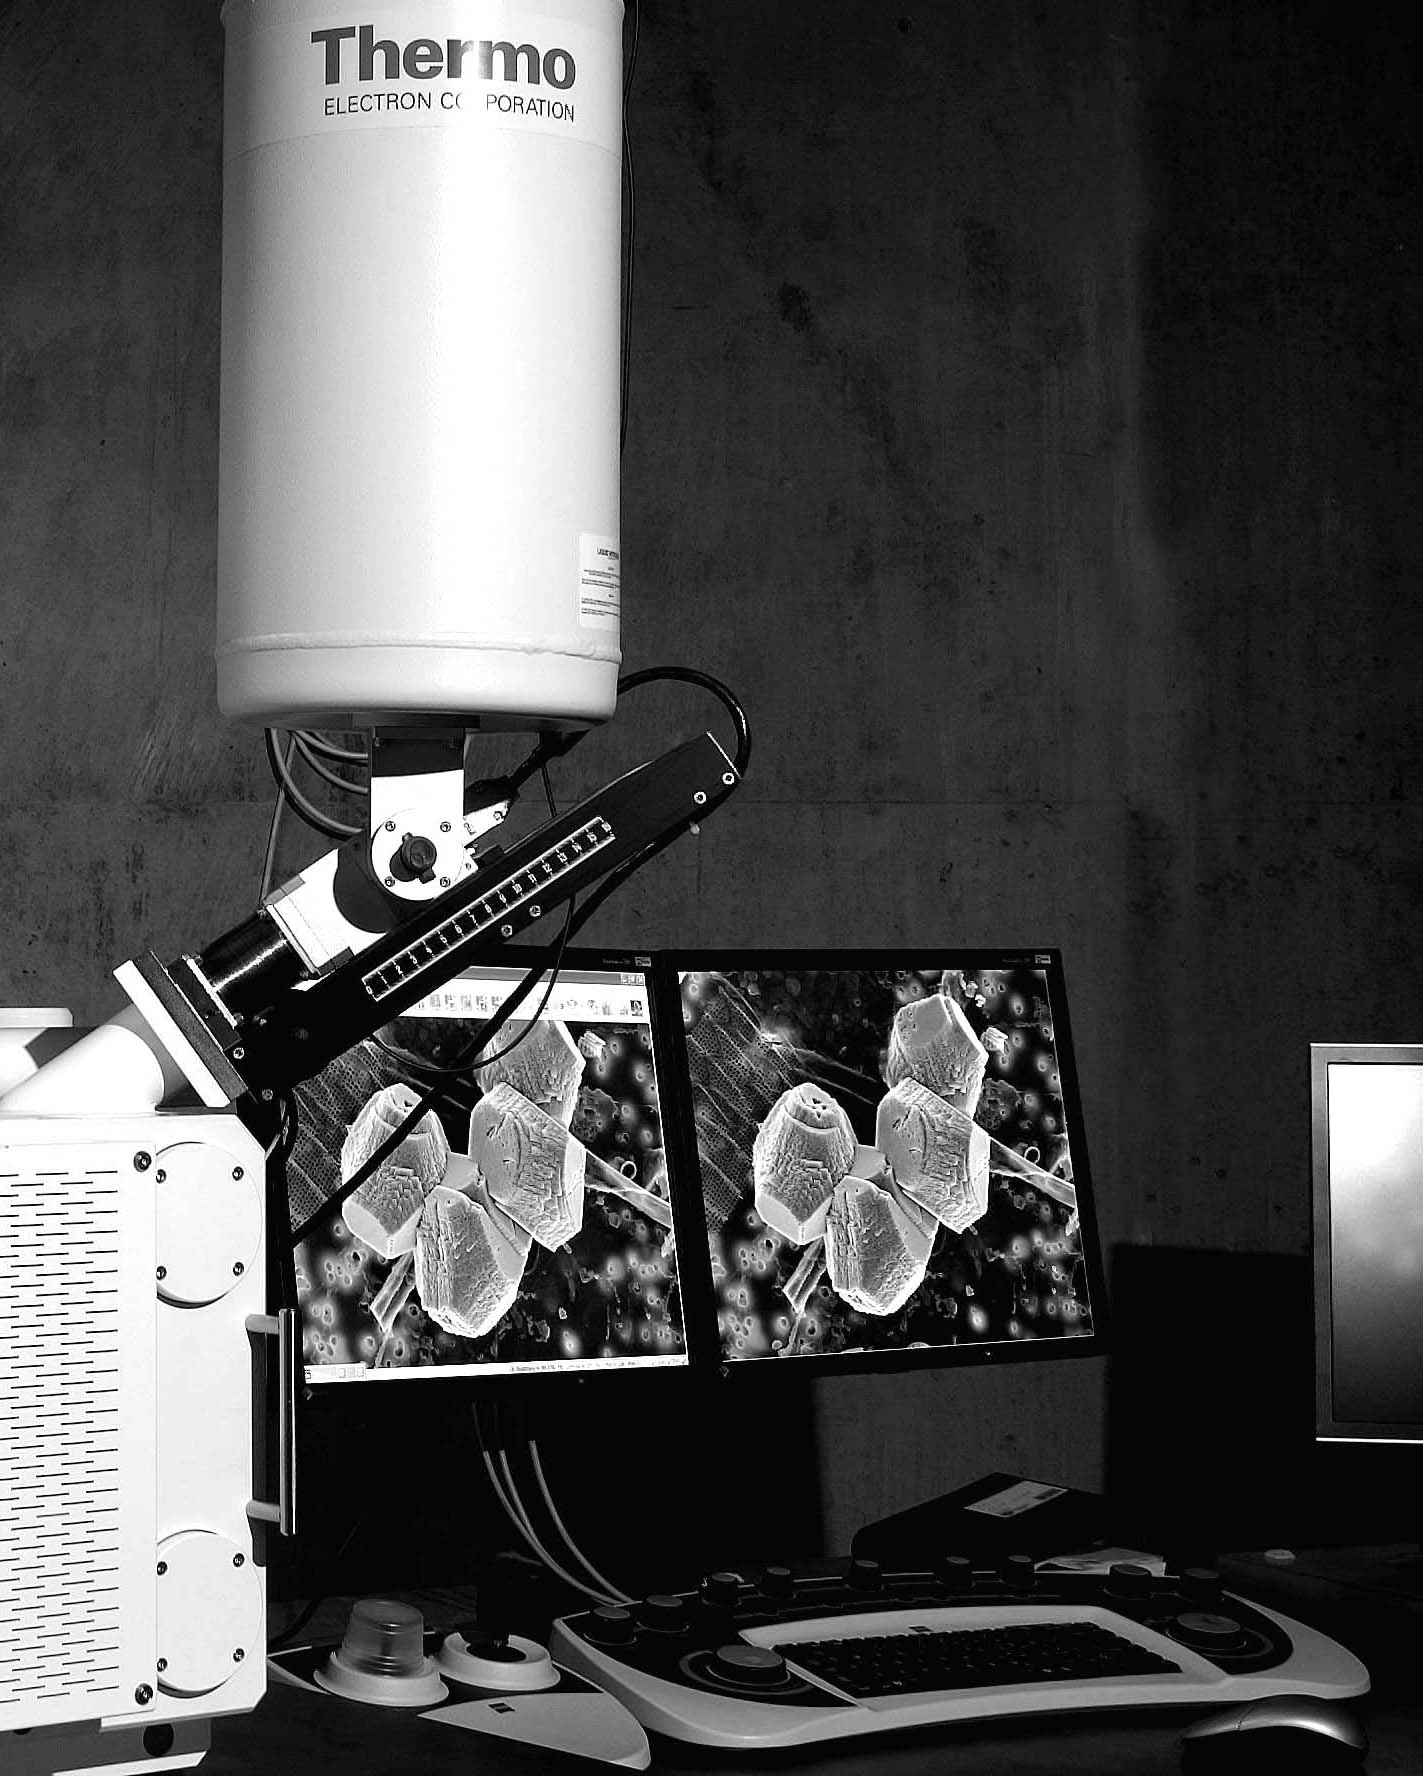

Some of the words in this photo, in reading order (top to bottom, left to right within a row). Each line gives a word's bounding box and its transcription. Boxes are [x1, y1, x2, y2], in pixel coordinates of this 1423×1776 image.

[311, 24, 576, 90] Thermo
[325, 92, 431, 116] ELECTRON
[440, 92, 574, 123] CPORATION
[542, 863, 552, 873] 12
